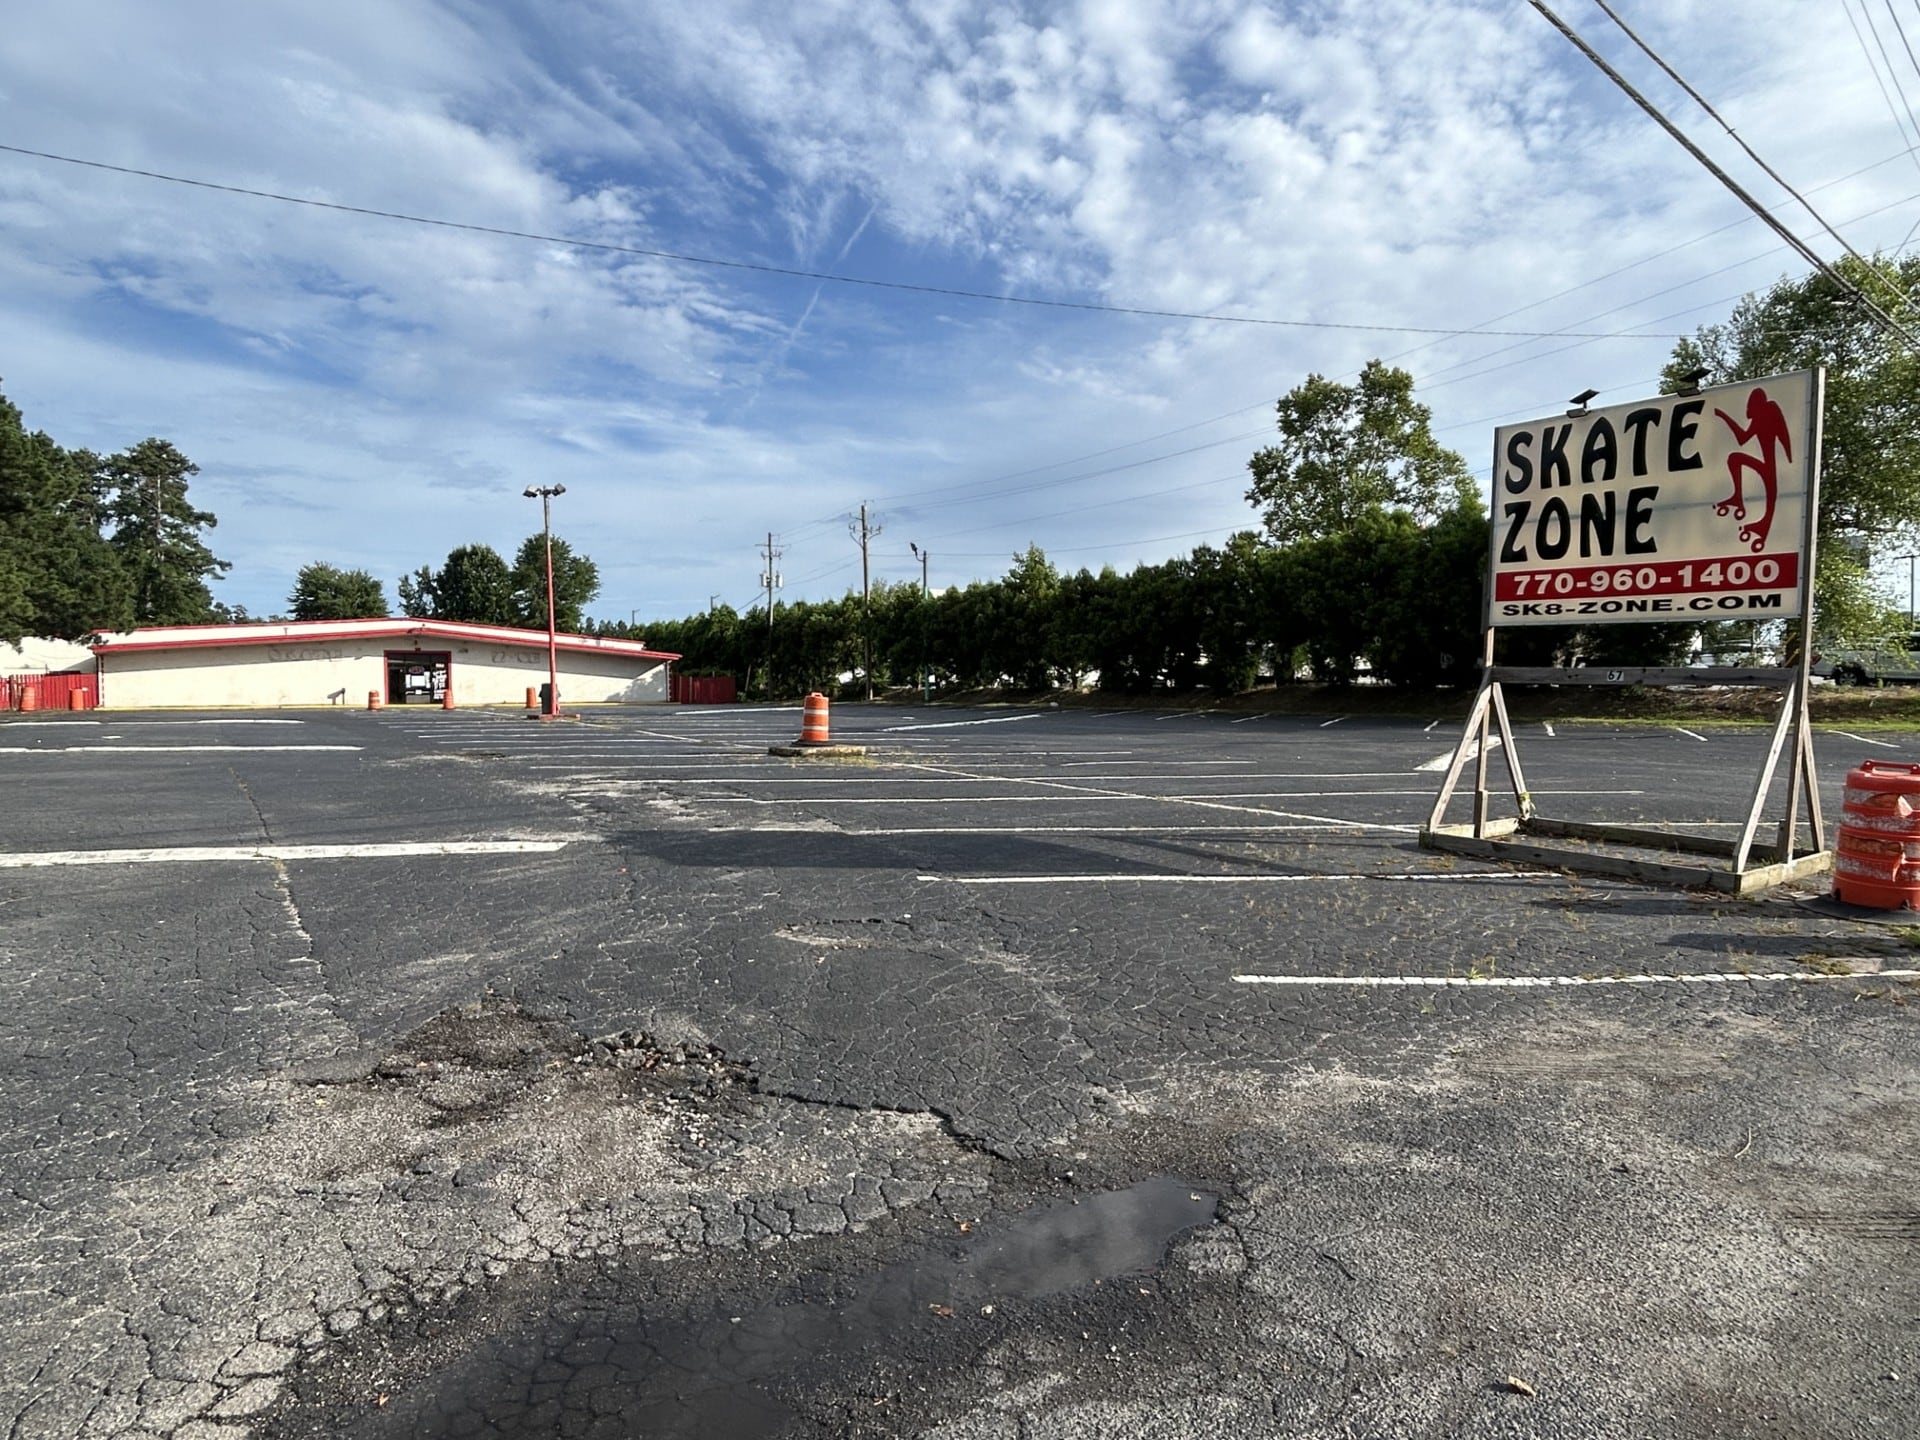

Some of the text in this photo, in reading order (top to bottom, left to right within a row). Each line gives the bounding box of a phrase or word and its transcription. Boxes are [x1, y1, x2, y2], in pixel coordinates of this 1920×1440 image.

[1505, 400, 1705, 494] SKATE
[1500, 486, 1659, 563] ZONE
[1514, 559, 1780, 596] 770-960-1400
[1502, 594, 1782, 616] SK8-ZONE.COM
[1608, 670, 1623, 681] 67
